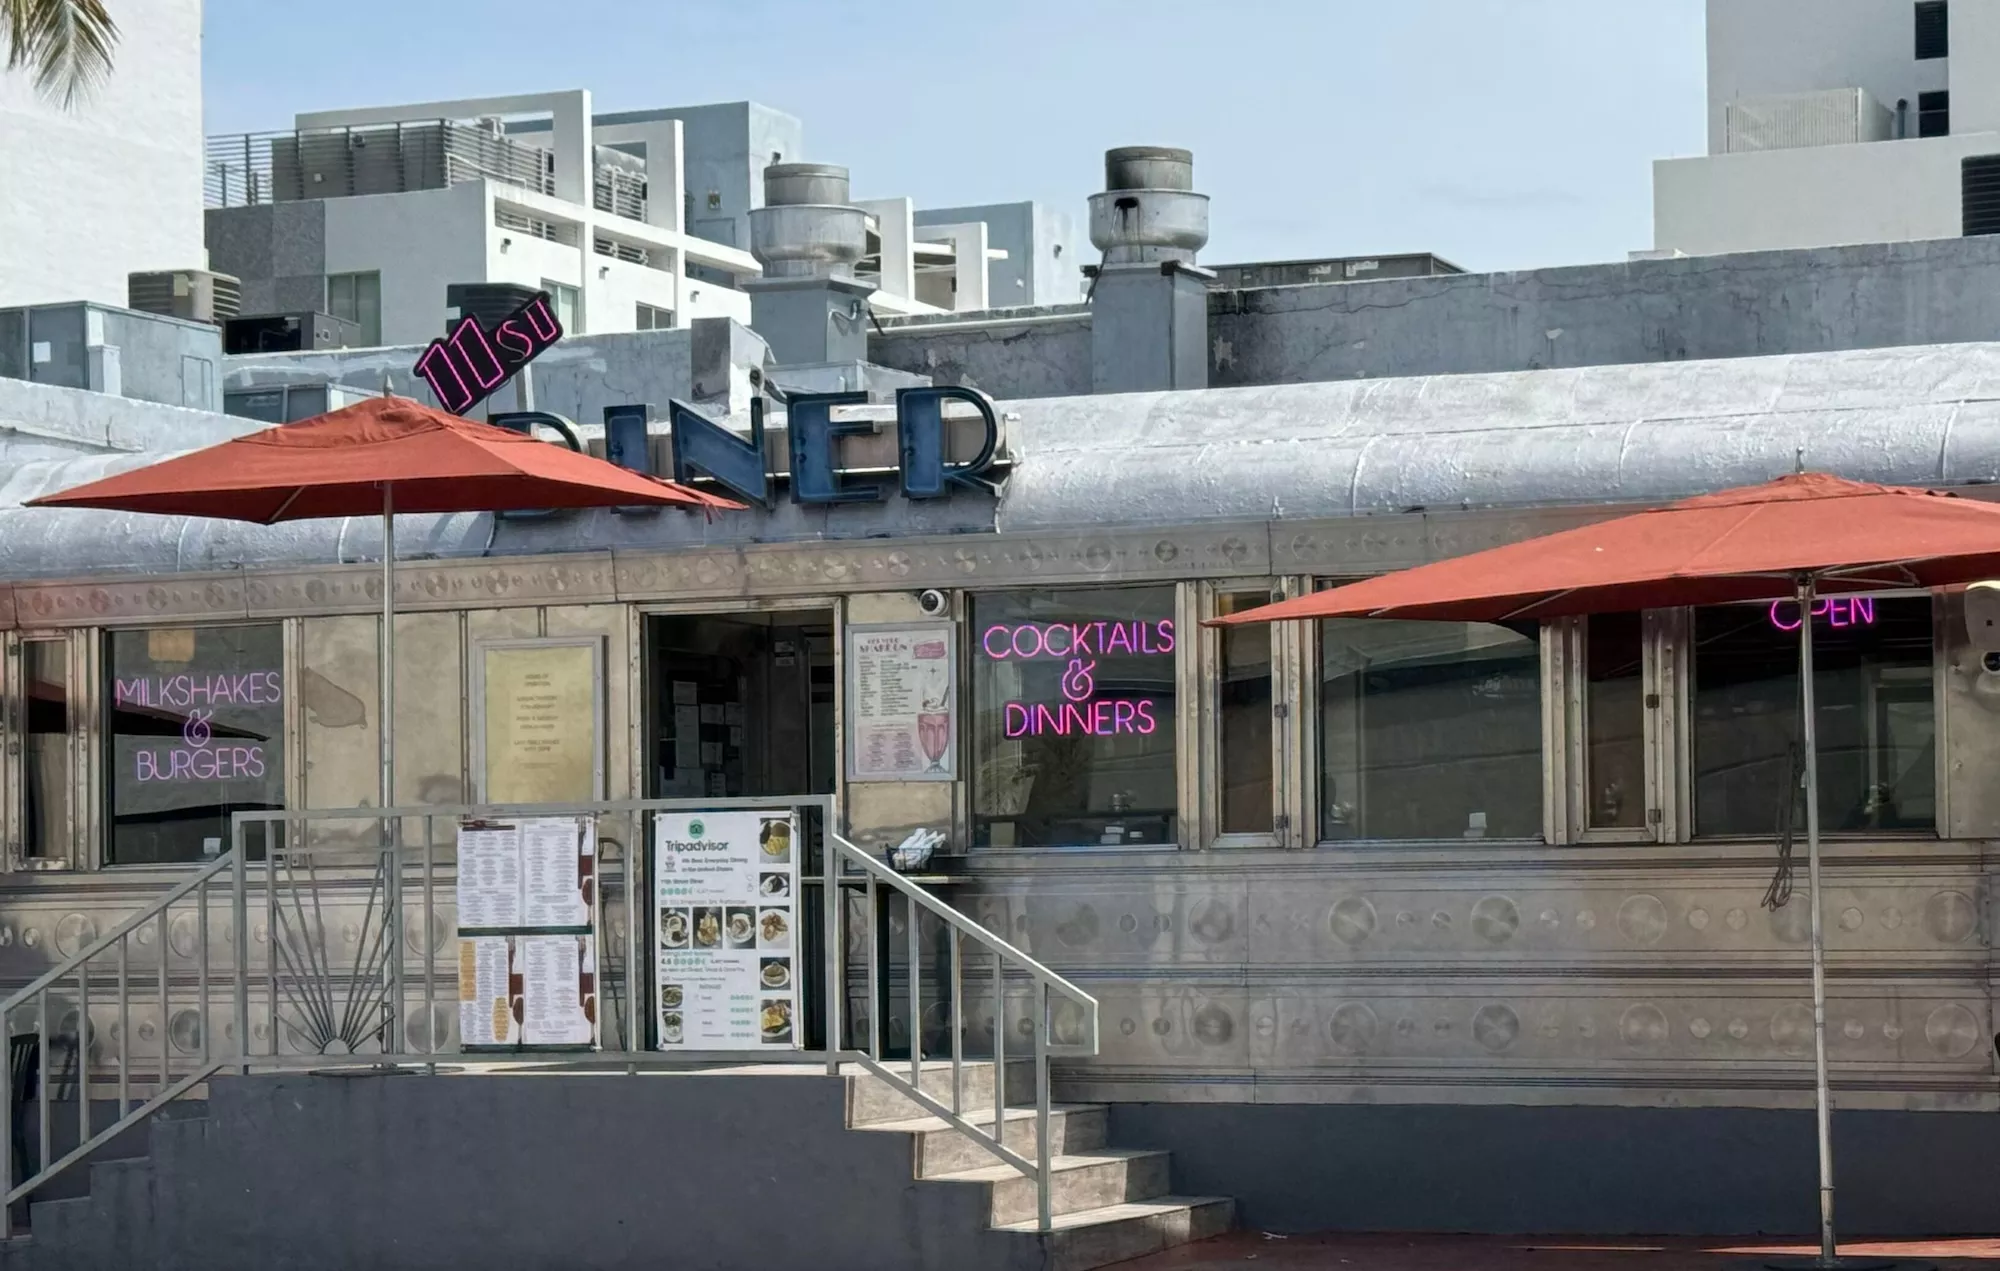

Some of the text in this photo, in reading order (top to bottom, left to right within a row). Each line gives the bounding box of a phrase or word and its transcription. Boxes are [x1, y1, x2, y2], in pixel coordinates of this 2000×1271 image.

[983, 619, 1174, 658] COCKTAILS
[116, 671, 281, 707] MILKSHAKES
[1062, 658, 1096, 702] &
[183, 708, 214, 748] &
[1005, 700, 1156, 737] DINNERS
[137, 746, 265, 781] BURGERS
[664, 840, 729, 854] Tripadvisor
